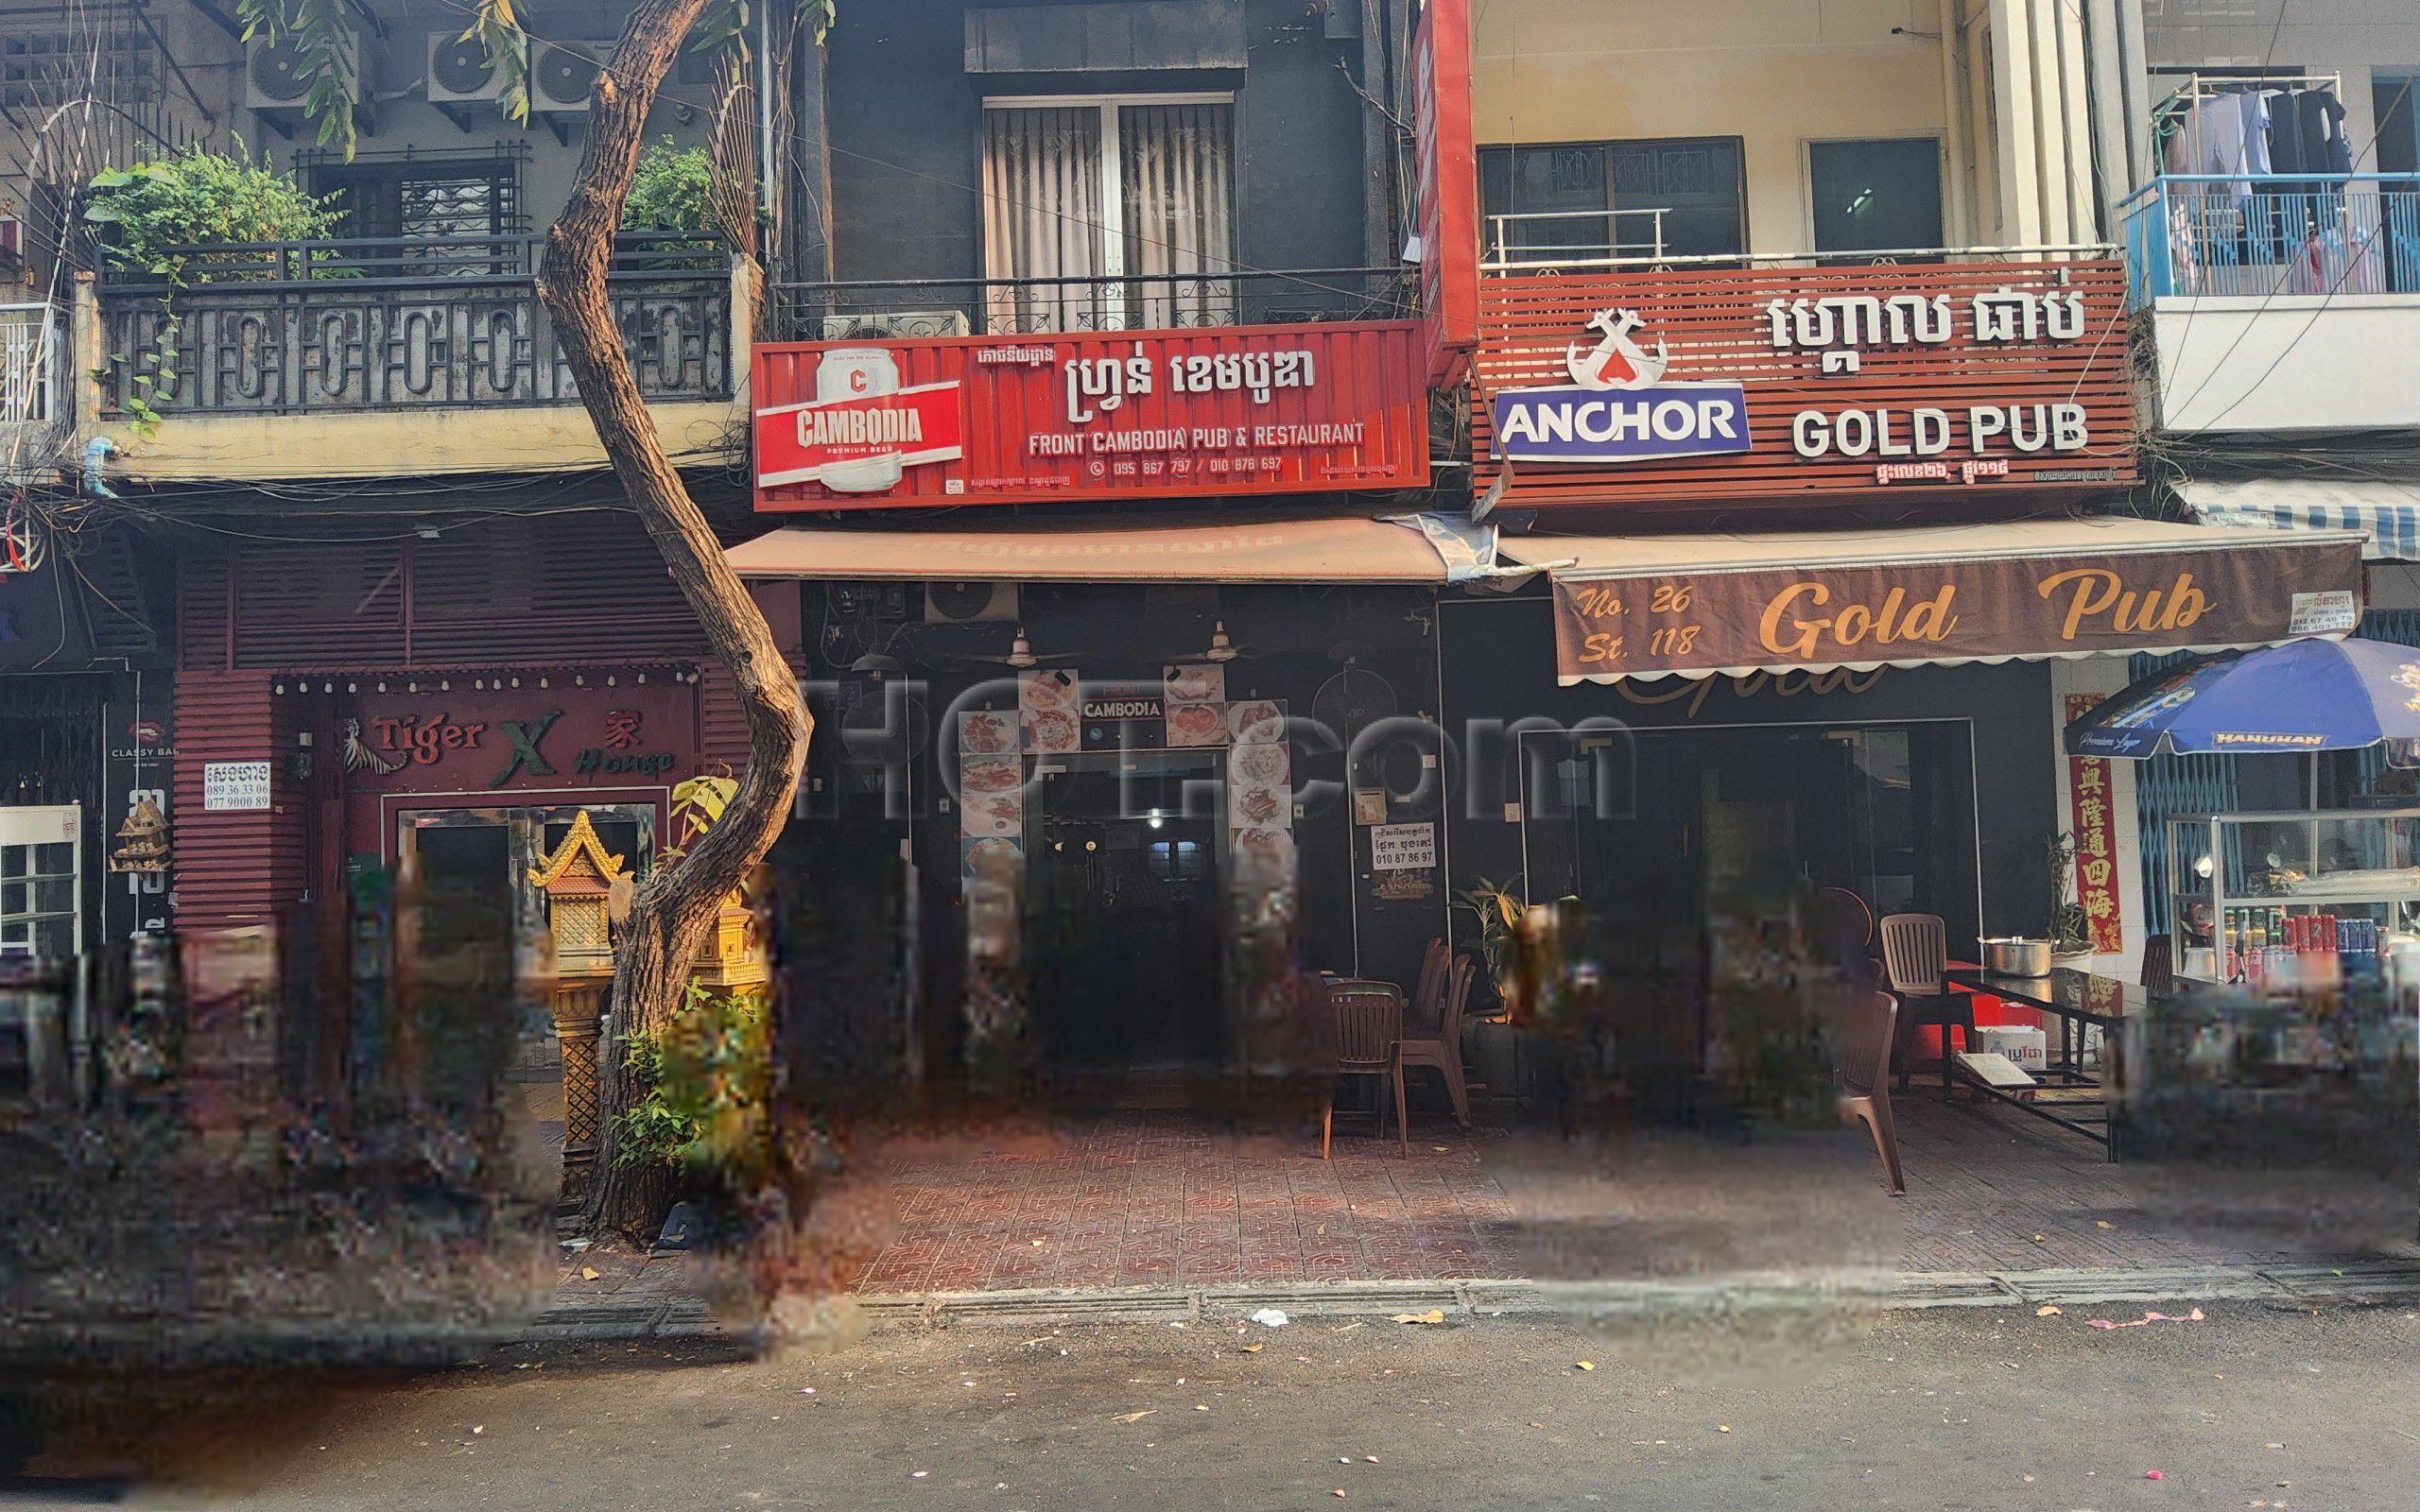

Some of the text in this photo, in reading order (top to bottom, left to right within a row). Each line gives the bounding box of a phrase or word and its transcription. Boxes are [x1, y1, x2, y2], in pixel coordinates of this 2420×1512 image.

[1767, 266, 2084, 372] ហ្គោល ផាប់
[1170, 351, 1315, 404] ខេមបូឌា
[797, 407, 924, 448] CAMBODIA
[1029, 422, 1365, 455] FRONT CAMBODIA PUB & RESTAURANT
[1500, 400, 1737, 443] ANCHOR
[1793, 404, 2088, 457] GOLD PUB
[1143, 461, 1163, 474] 867
[1169, 460, 1191, 472] 797
[1210, 459, 1228, 472] 010
[1235, 458, 1255, 471] 878
[1262, 457, 1282, 470] 697
[1576, 585, 1693, 620] No. 26
[1758, 568, 2218, 661] Gold Pub
[1579, 627, 1701, 662] St. 118
[1084, 701, 1161, 718] CAMBODIA
[112, 748, 153, 757] CLASSY
[374, 710, 644, 788] Tiger X 家
[206, 783, 268, 796] 089 36 33 06
[206, 796, 268, 809] 077 9000 89
[1375, 851, 1433, 865] 010 87 86 97
